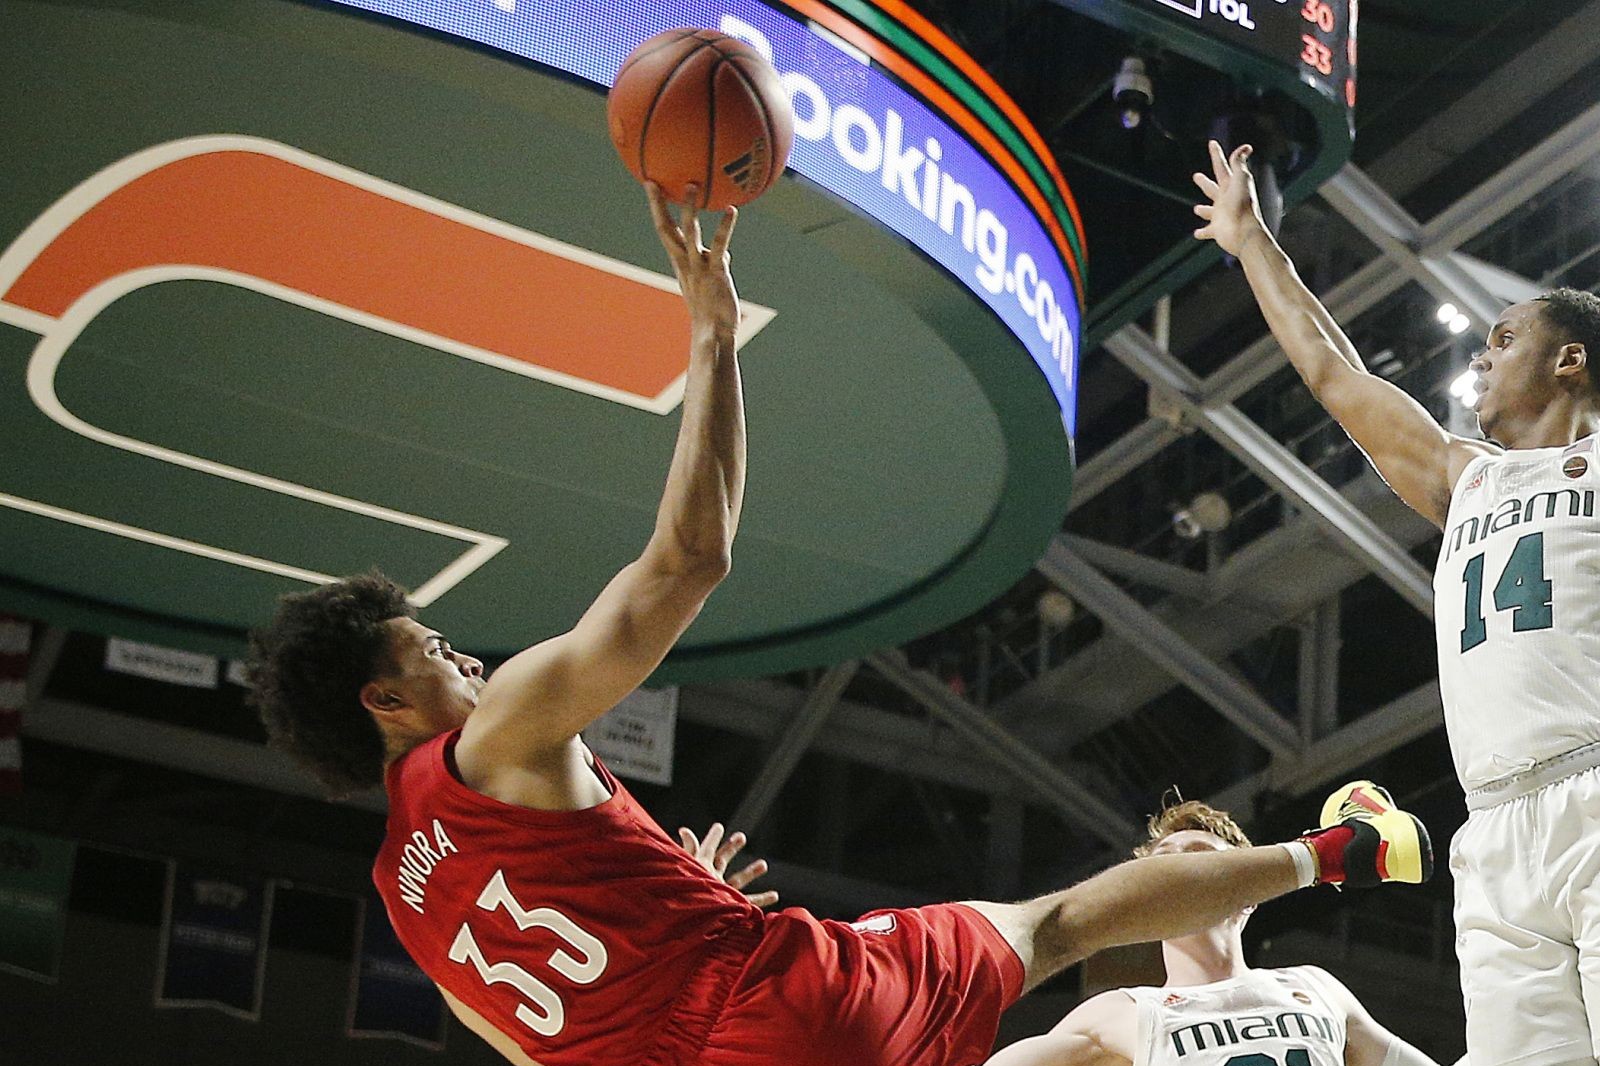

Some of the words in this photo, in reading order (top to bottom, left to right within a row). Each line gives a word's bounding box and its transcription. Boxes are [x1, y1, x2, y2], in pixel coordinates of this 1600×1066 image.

[1461, 531, 1553, 654] 14
[398, 819, 459, 914] NWORA
[448, 869, 608, 1037] 33
